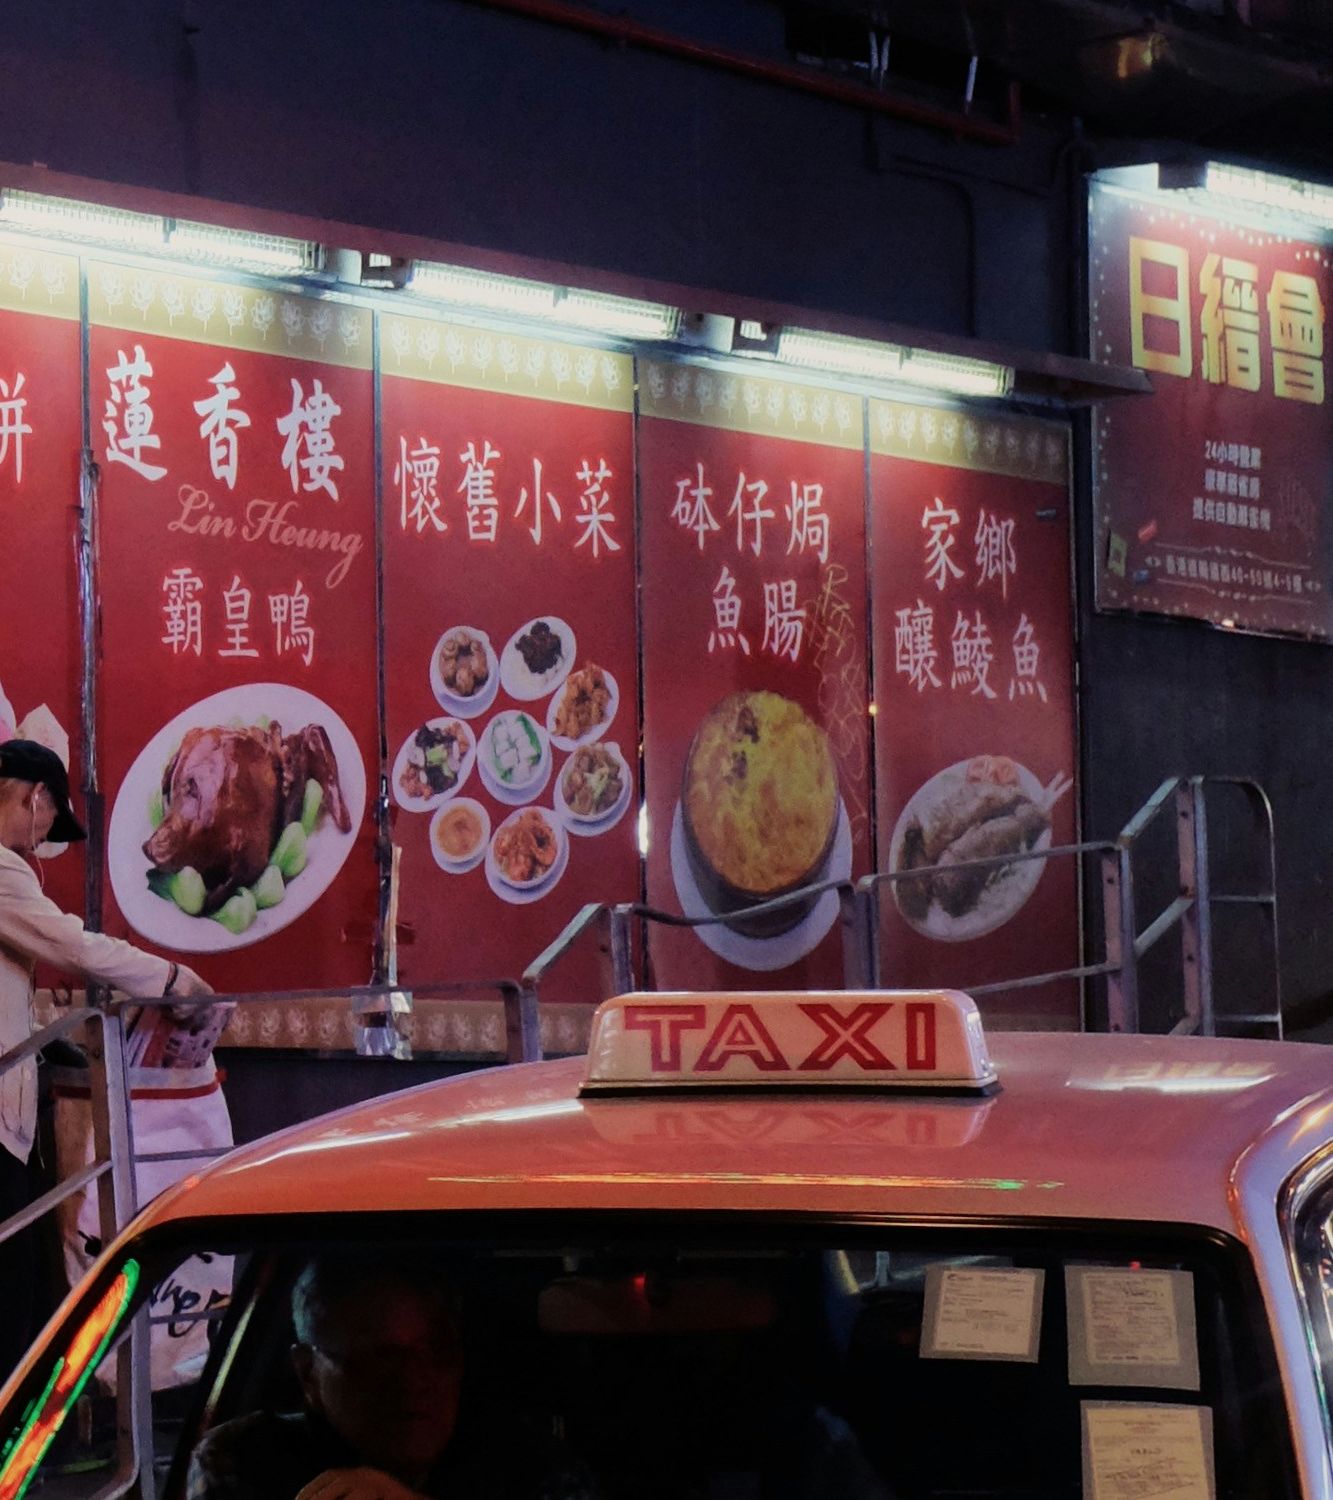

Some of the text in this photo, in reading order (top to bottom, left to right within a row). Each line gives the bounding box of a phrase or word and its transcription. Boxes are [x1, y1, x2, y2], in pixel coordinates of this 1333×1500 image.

[101, 346, 344, 503] 蓮香樓
[168, 484, 364, 590] Lin Heung
[394, 435, 622, 559] 懷舊小菜
[670, 463, 831, 565] 砵仔焗
[920, 498, 1016, 599] 家鄉
[160, 565, 316, 669] 霸皇鴨
[706, 567, 808, 664] 魚腸
[894, 606, 1049, 703] 釀鯪魚
[625, 1003, 936, 1071] TAXI
